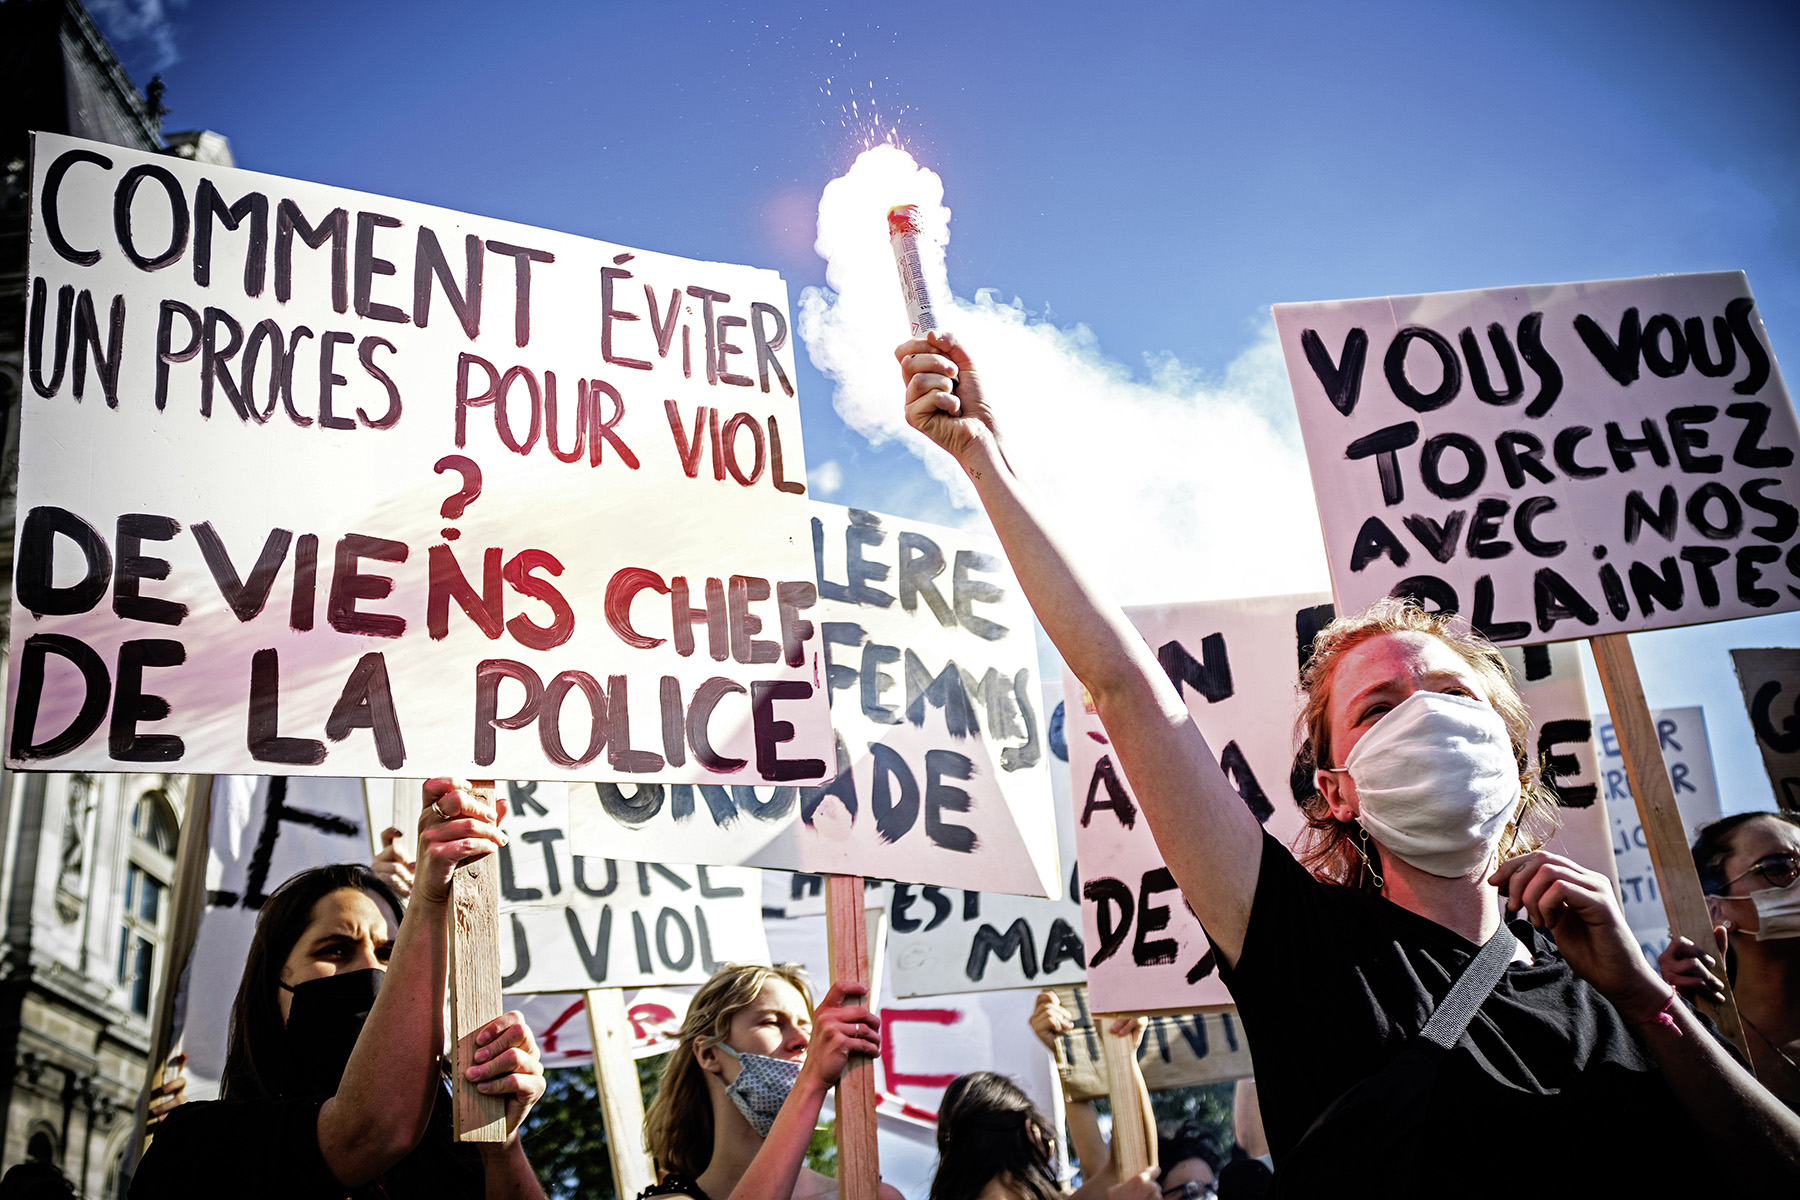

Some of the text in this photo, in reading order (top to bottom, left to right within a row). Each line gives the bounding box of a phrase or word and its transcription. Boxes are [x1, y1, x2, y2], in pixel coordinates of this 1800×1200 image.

[41, 148, 556, 347] COMMENT
[30, 276, 806, 496] UN PROCES POUR VIOL
[1301, 297, 1771, 418] VOUS VOUS
[1344, 401, 1795, 506] TORCHEZ
[15, 505, 817, 667] DEVIENS CHEF
[1350, 478, 1799, 572] AVEC NOS
[10, 632, 827, 781] DE LA POLICE
[565, 904, 737, 983] VIOL
